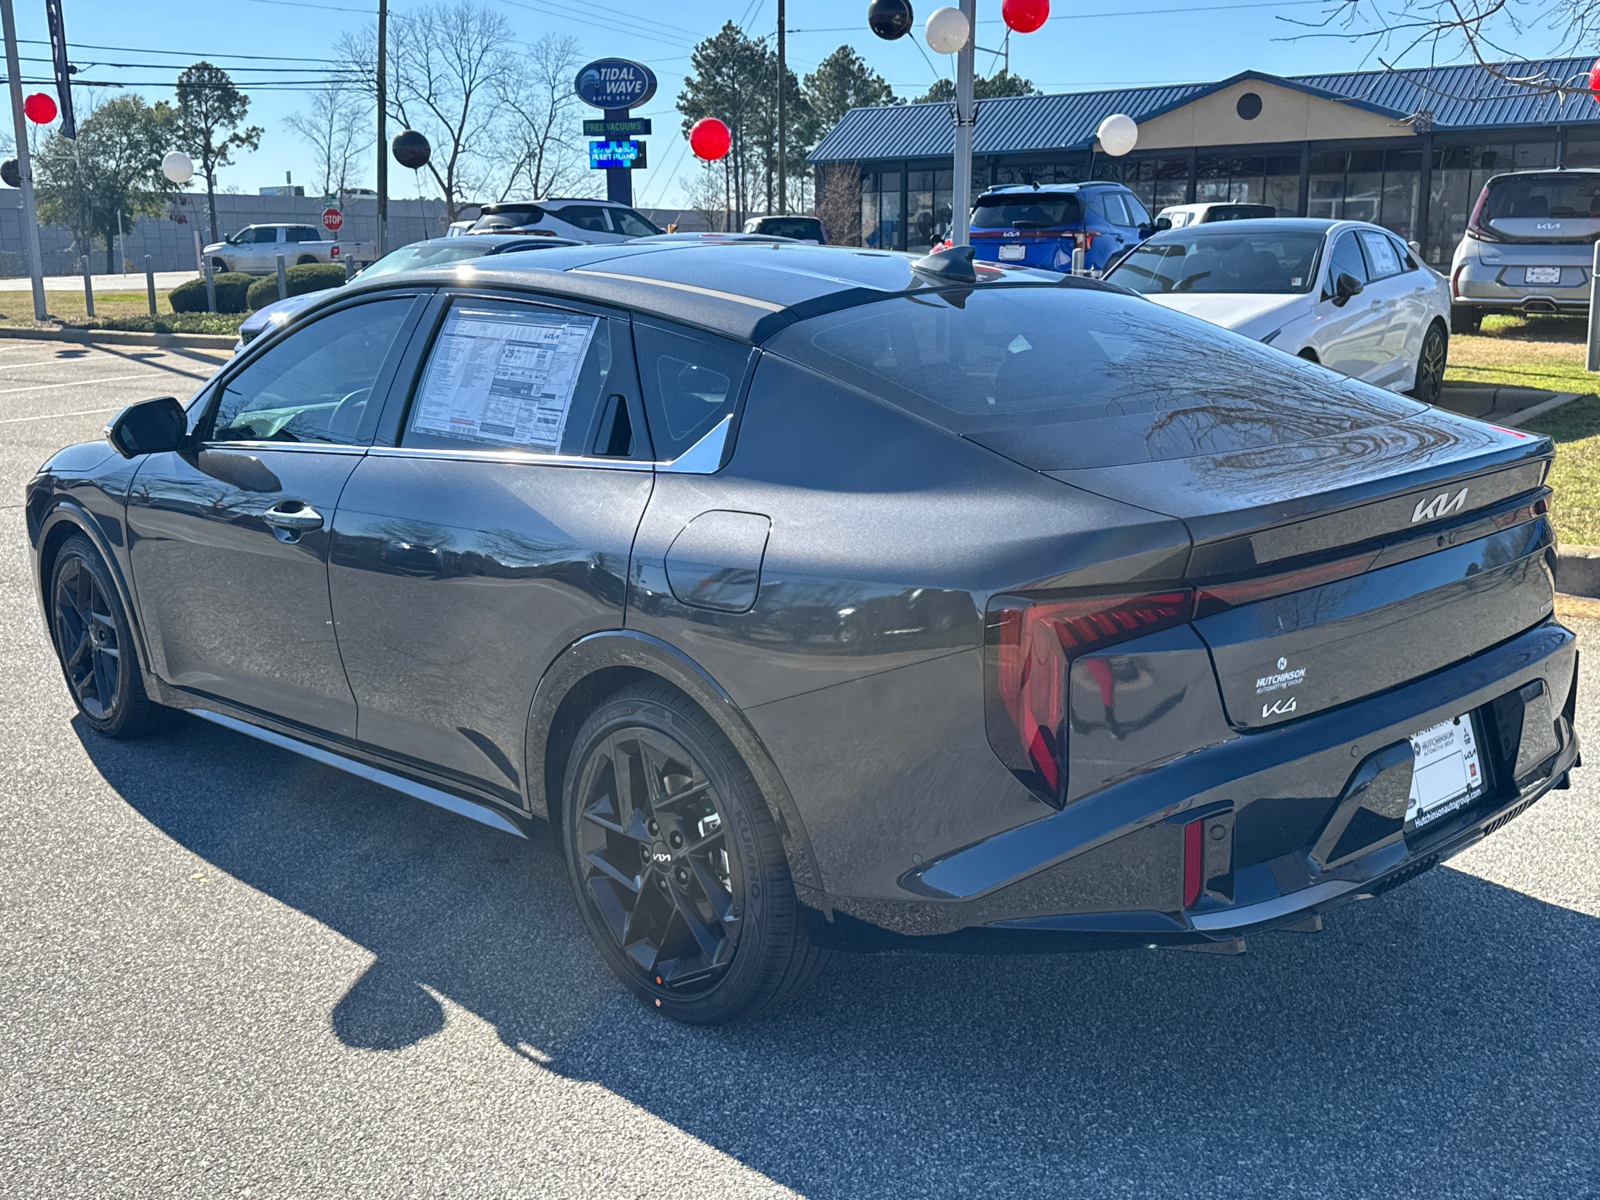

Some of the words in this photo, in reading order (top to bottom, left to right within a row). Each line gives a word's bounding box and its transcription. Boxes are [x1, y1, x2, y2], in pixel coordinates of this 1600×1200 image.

[600, 67, 635, 81] TIDAL
[606, 80, 642, 94] WAVE
[585, 123, 604, 132] FREE
[606, 121, 641, 132] VACUUMS
[324, 215, 342, 225] STOP
[1411, 487, 1469, 523] KIA
[1255, 667, 1307, 688] HUTCHINSON
[1255, 682, 1287, 695] AUTOMOTIVE
[1287, 678, 1304, 687] GROUP
[1262, 696, 1297, 718] K4
[1414, 788, 1482, 829] Hutchinsonautogroup.com
[734, 809, 760, 900] KUMHO
